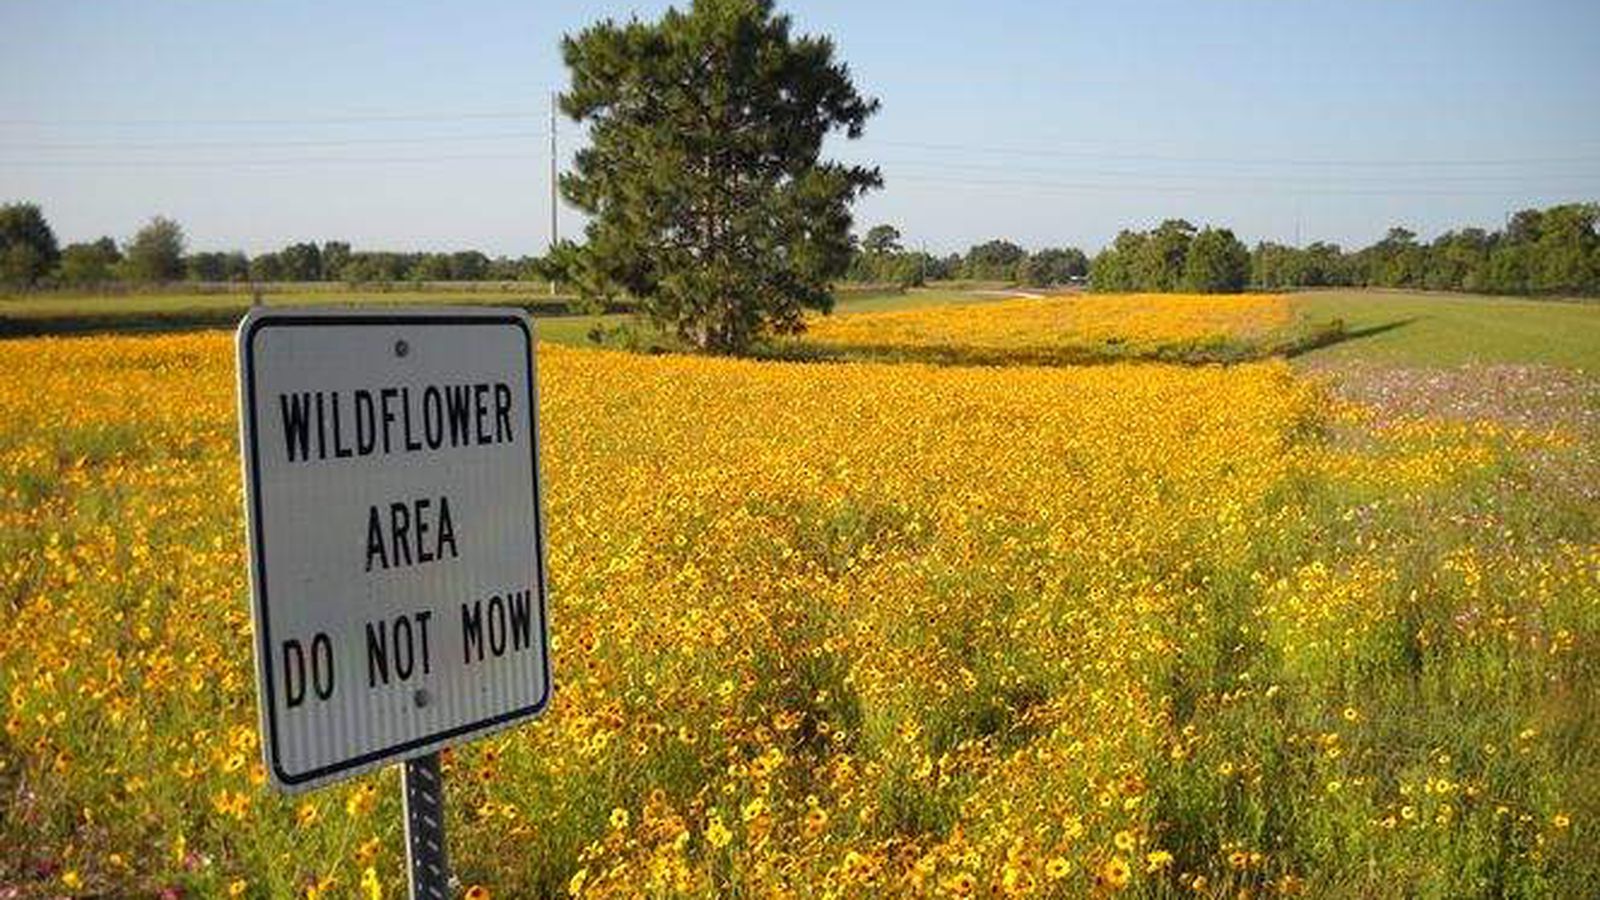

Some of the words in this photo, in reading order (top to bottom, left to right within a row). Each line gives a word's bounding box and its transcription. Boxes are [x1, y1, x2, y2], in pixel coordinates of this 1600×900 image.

[279, 383, 514, 464] WILDFLOWER
[364, 496, 459, 573] AREA
[282, 632, 335, 709] DO
[364, 611, 433, 689] NOT
[461, 590, 532, 665] MOW
